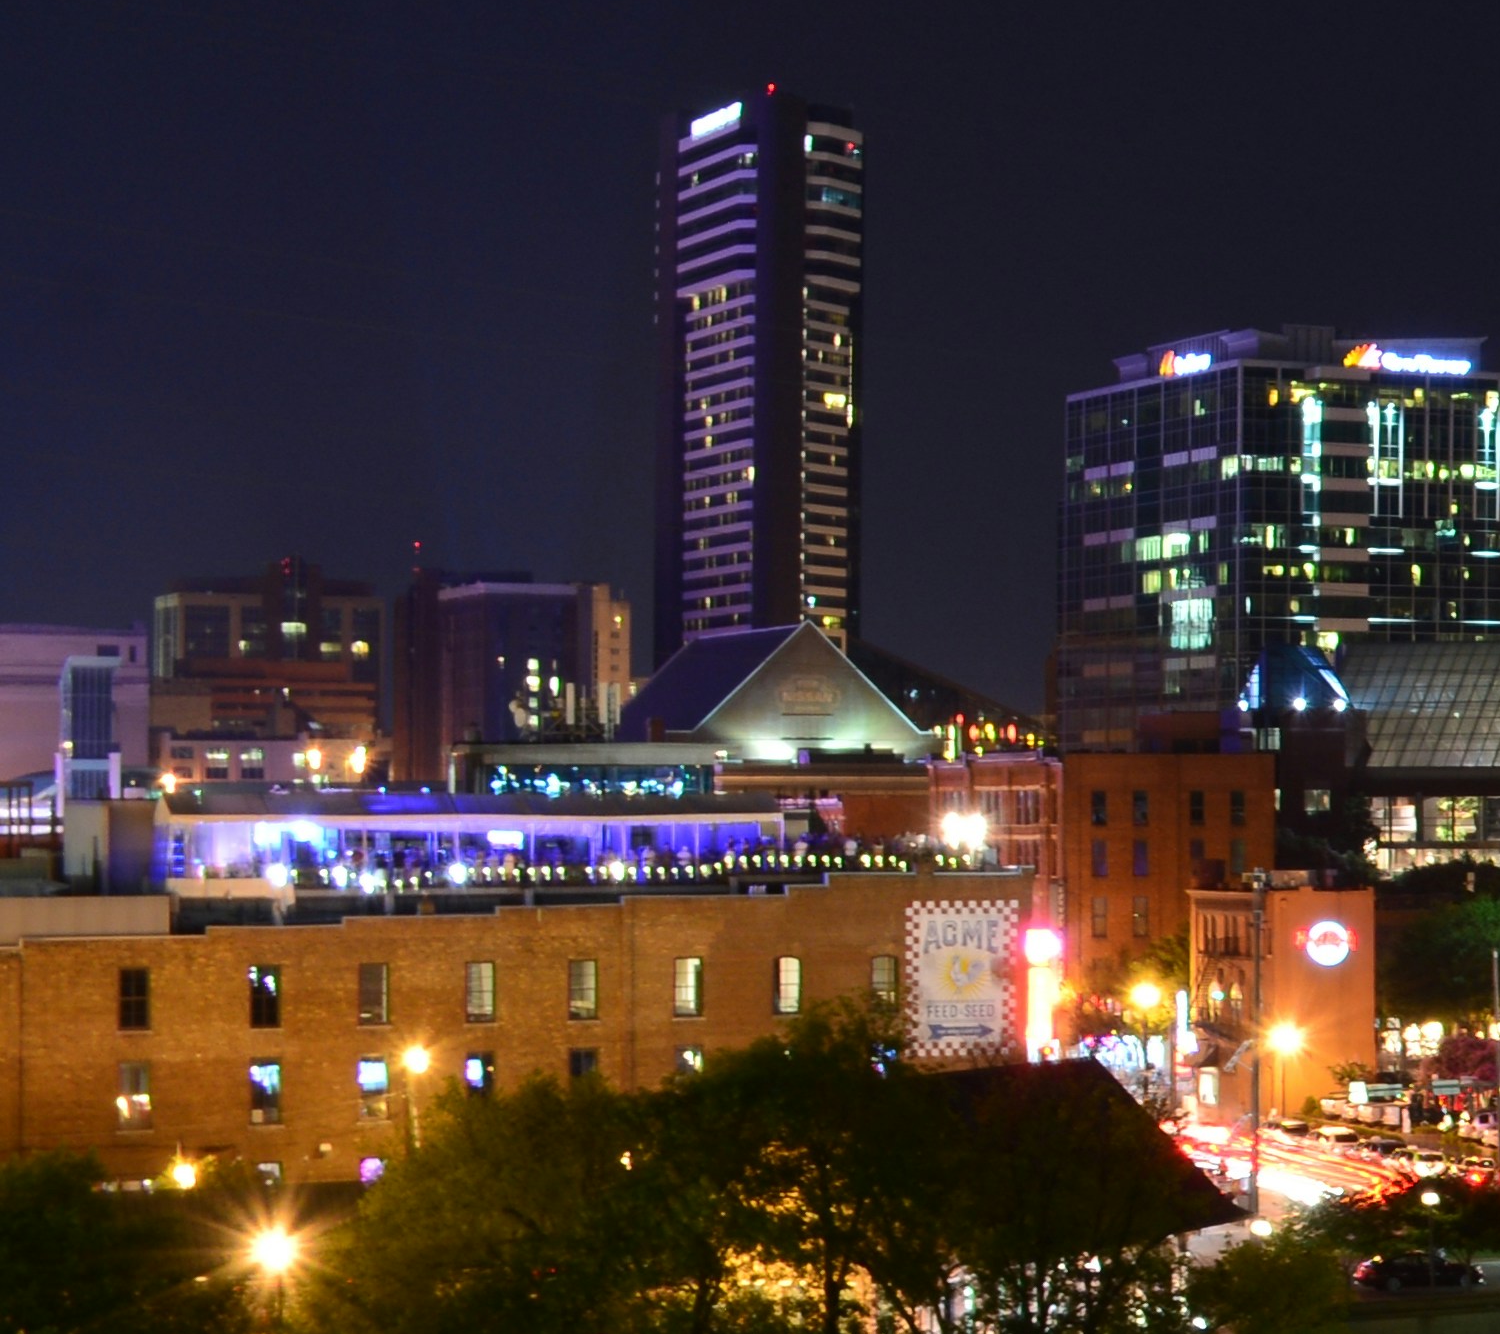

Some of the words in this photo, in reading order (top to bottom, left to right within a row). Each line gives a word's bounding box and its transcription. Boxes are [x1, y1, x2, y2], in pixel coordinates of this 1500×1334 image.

[923, 920, 1000, 954] ACME
[927, 1005, 957, 1018] FEED
[964, 1004, 995, 1017] SEED
